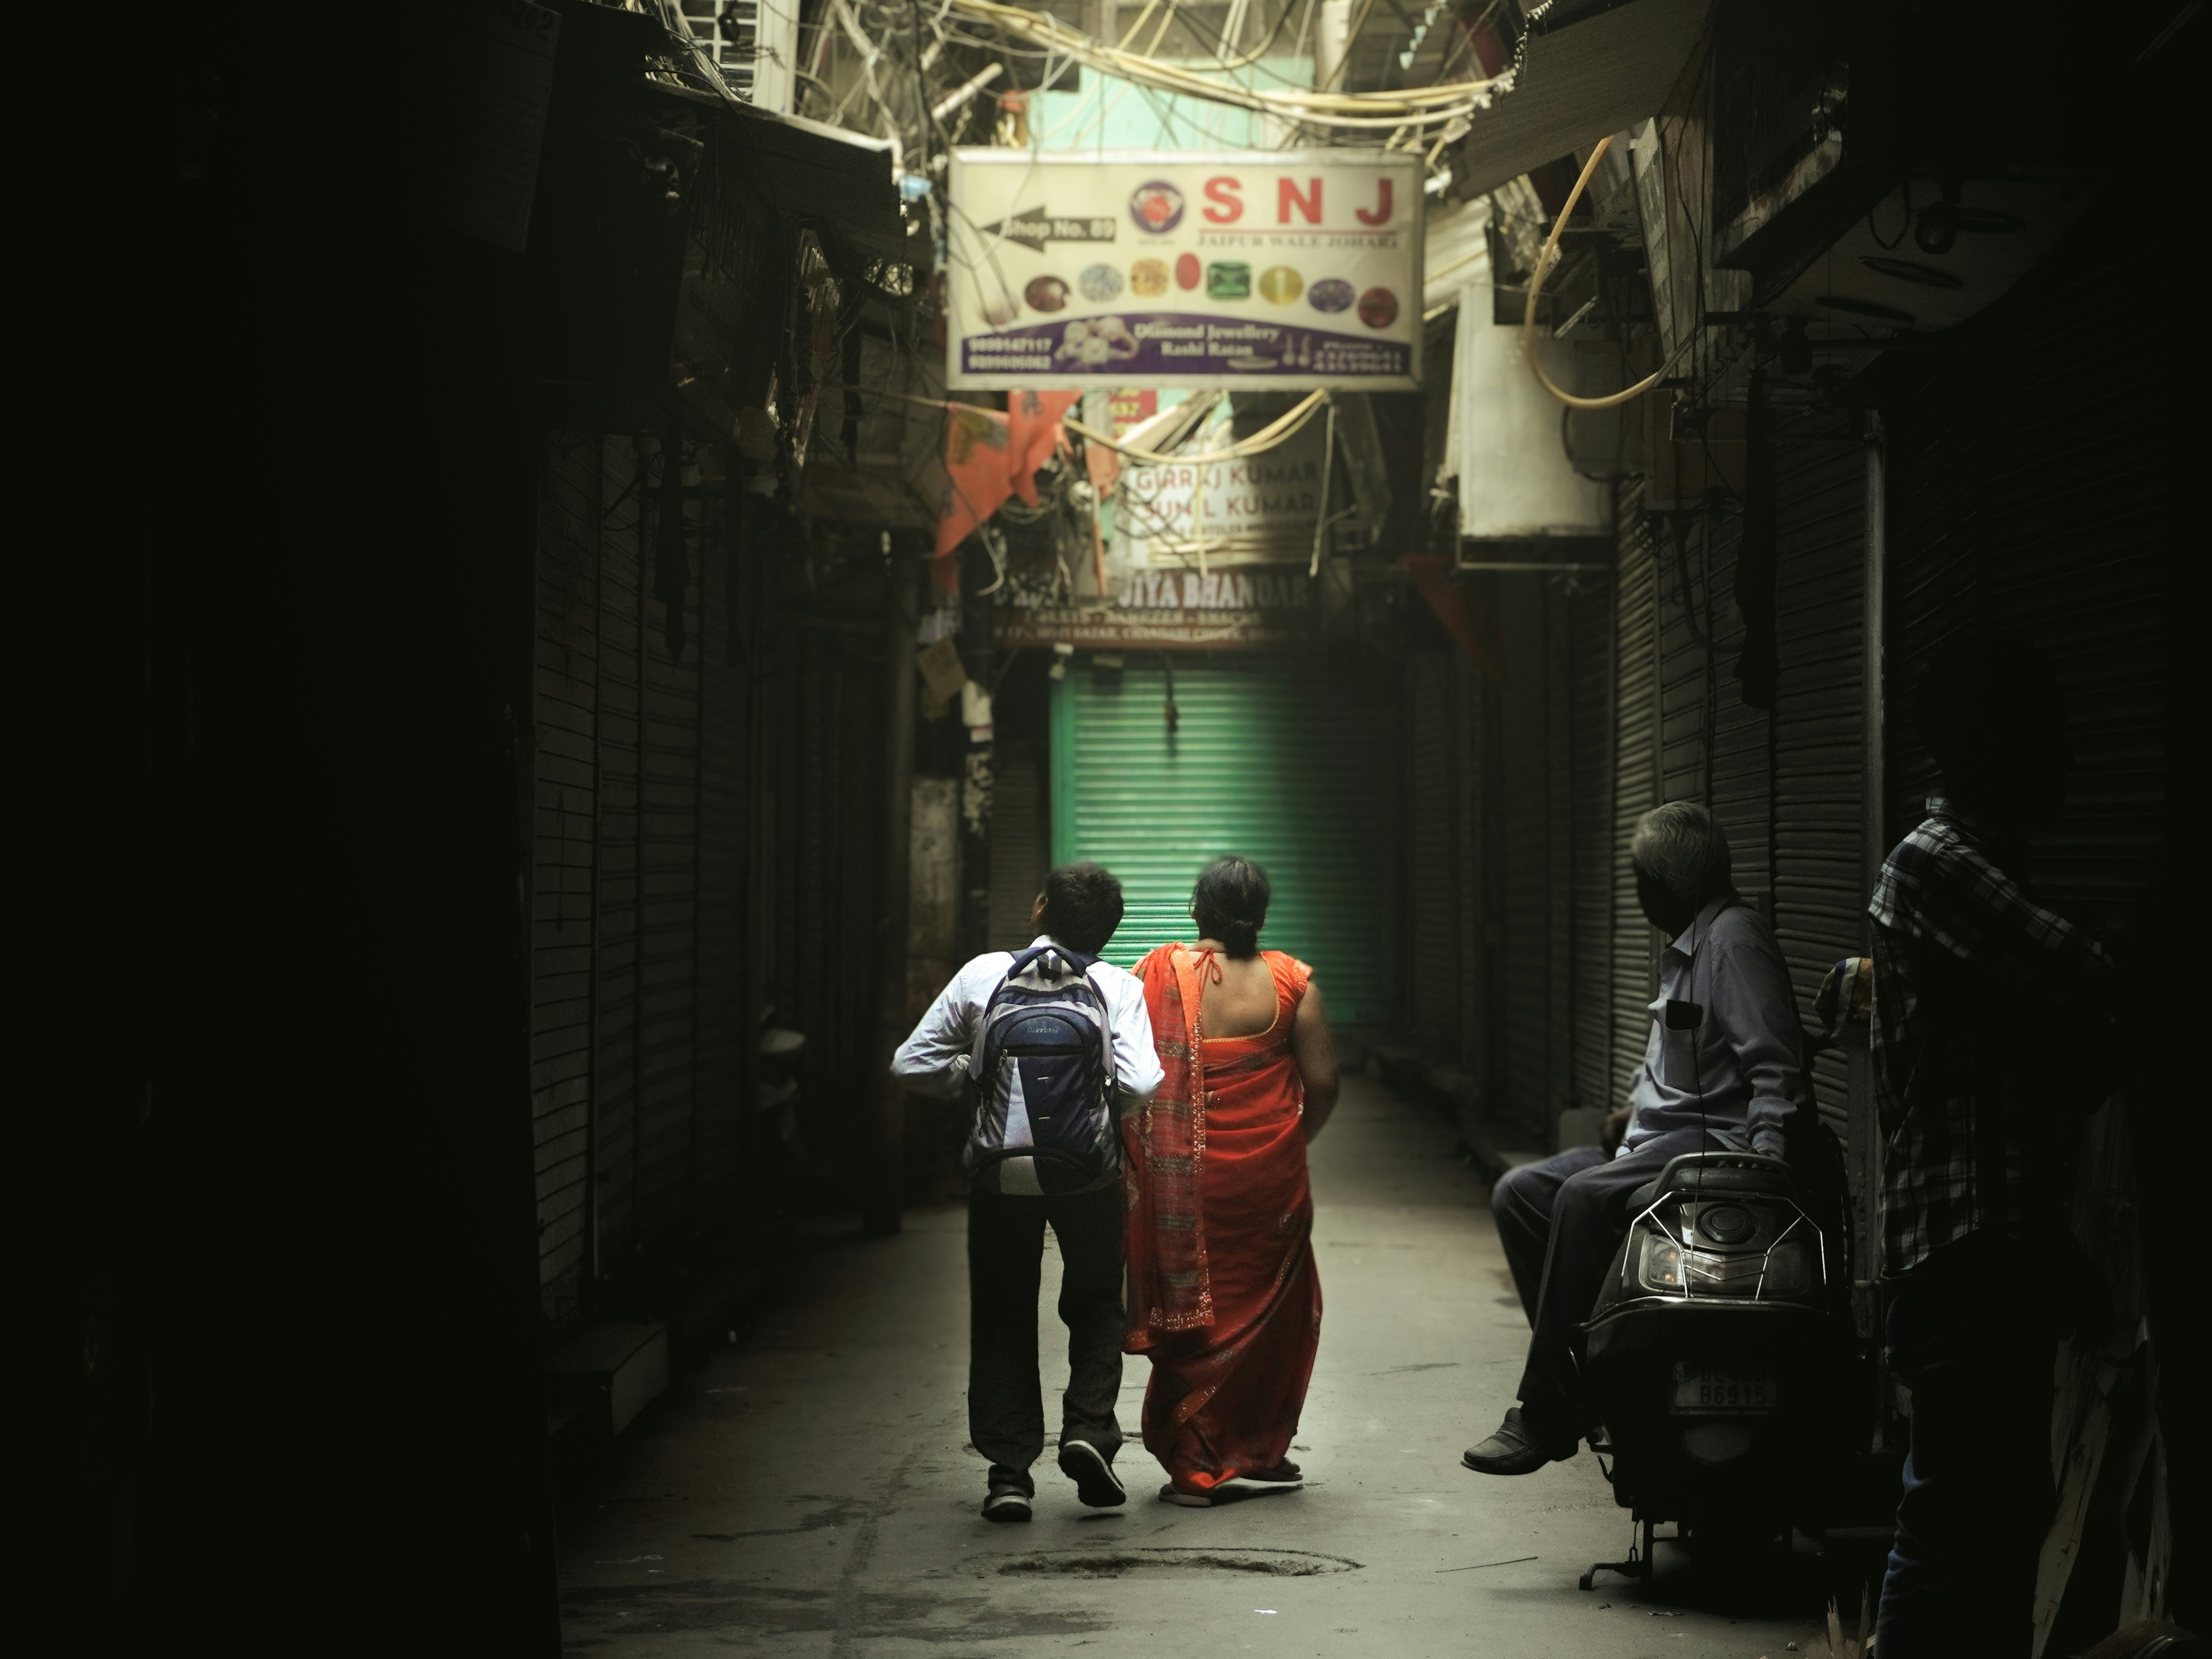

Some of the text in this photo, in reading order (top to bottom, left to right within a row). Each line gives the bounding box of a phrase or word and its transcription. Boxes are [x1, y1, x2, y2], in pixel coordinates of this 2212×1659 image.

[1004, 219, 1050, 240] Shop
[1054, 219, 1087, 237] No.
[1197, 236, 1398, 249] JAIPUR WALE JOHARI
[1134, 323, 1280, 343] Diamond Jewellery
[1161, 341, 1253, 356] Rashi Ratan
[1229, 462, 1318, 486] KUMAR
[1226, 492, 1315, 516] KUMAR
[1183, 572, 1308, 609] BHANDAR
[1700, 1384, 1764, 1405] B6915
